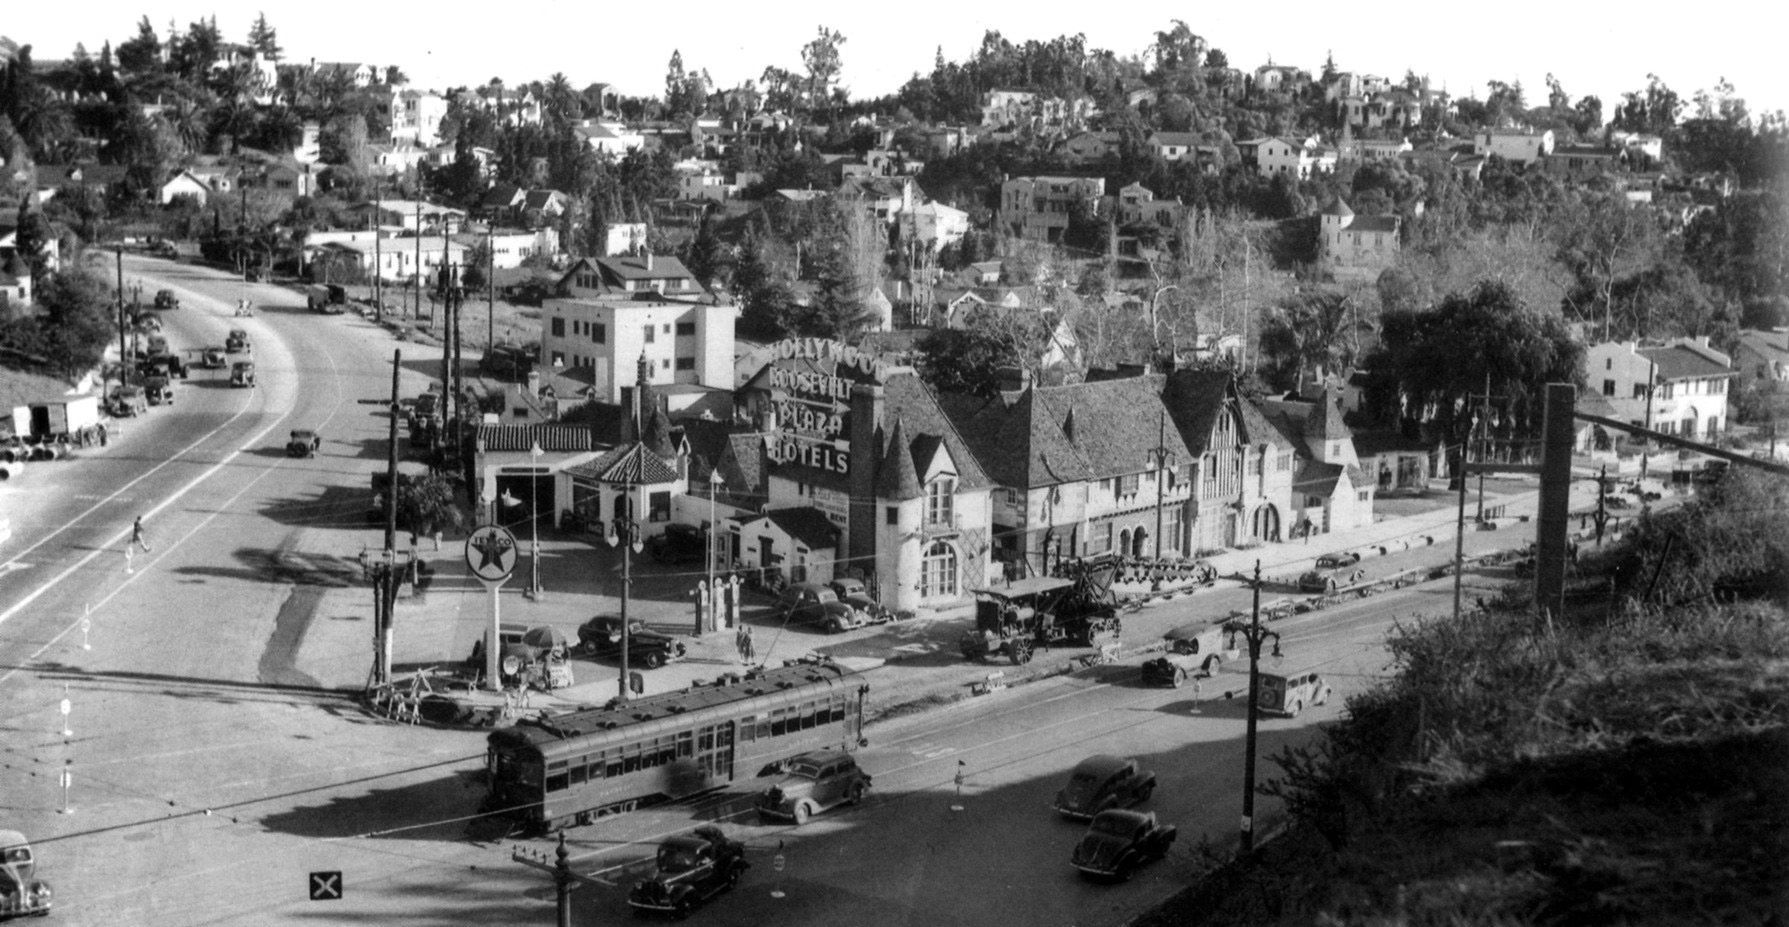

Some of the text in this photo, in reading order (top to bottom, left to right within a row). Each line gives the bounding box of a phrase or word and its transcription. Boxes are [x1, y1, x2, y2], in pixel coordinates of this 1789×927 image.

[769, 366, 855, 399] ROOSEVELT
[780, 402, 842, 435] PLAZA
[773, 440, 848, 473] HOTELS
